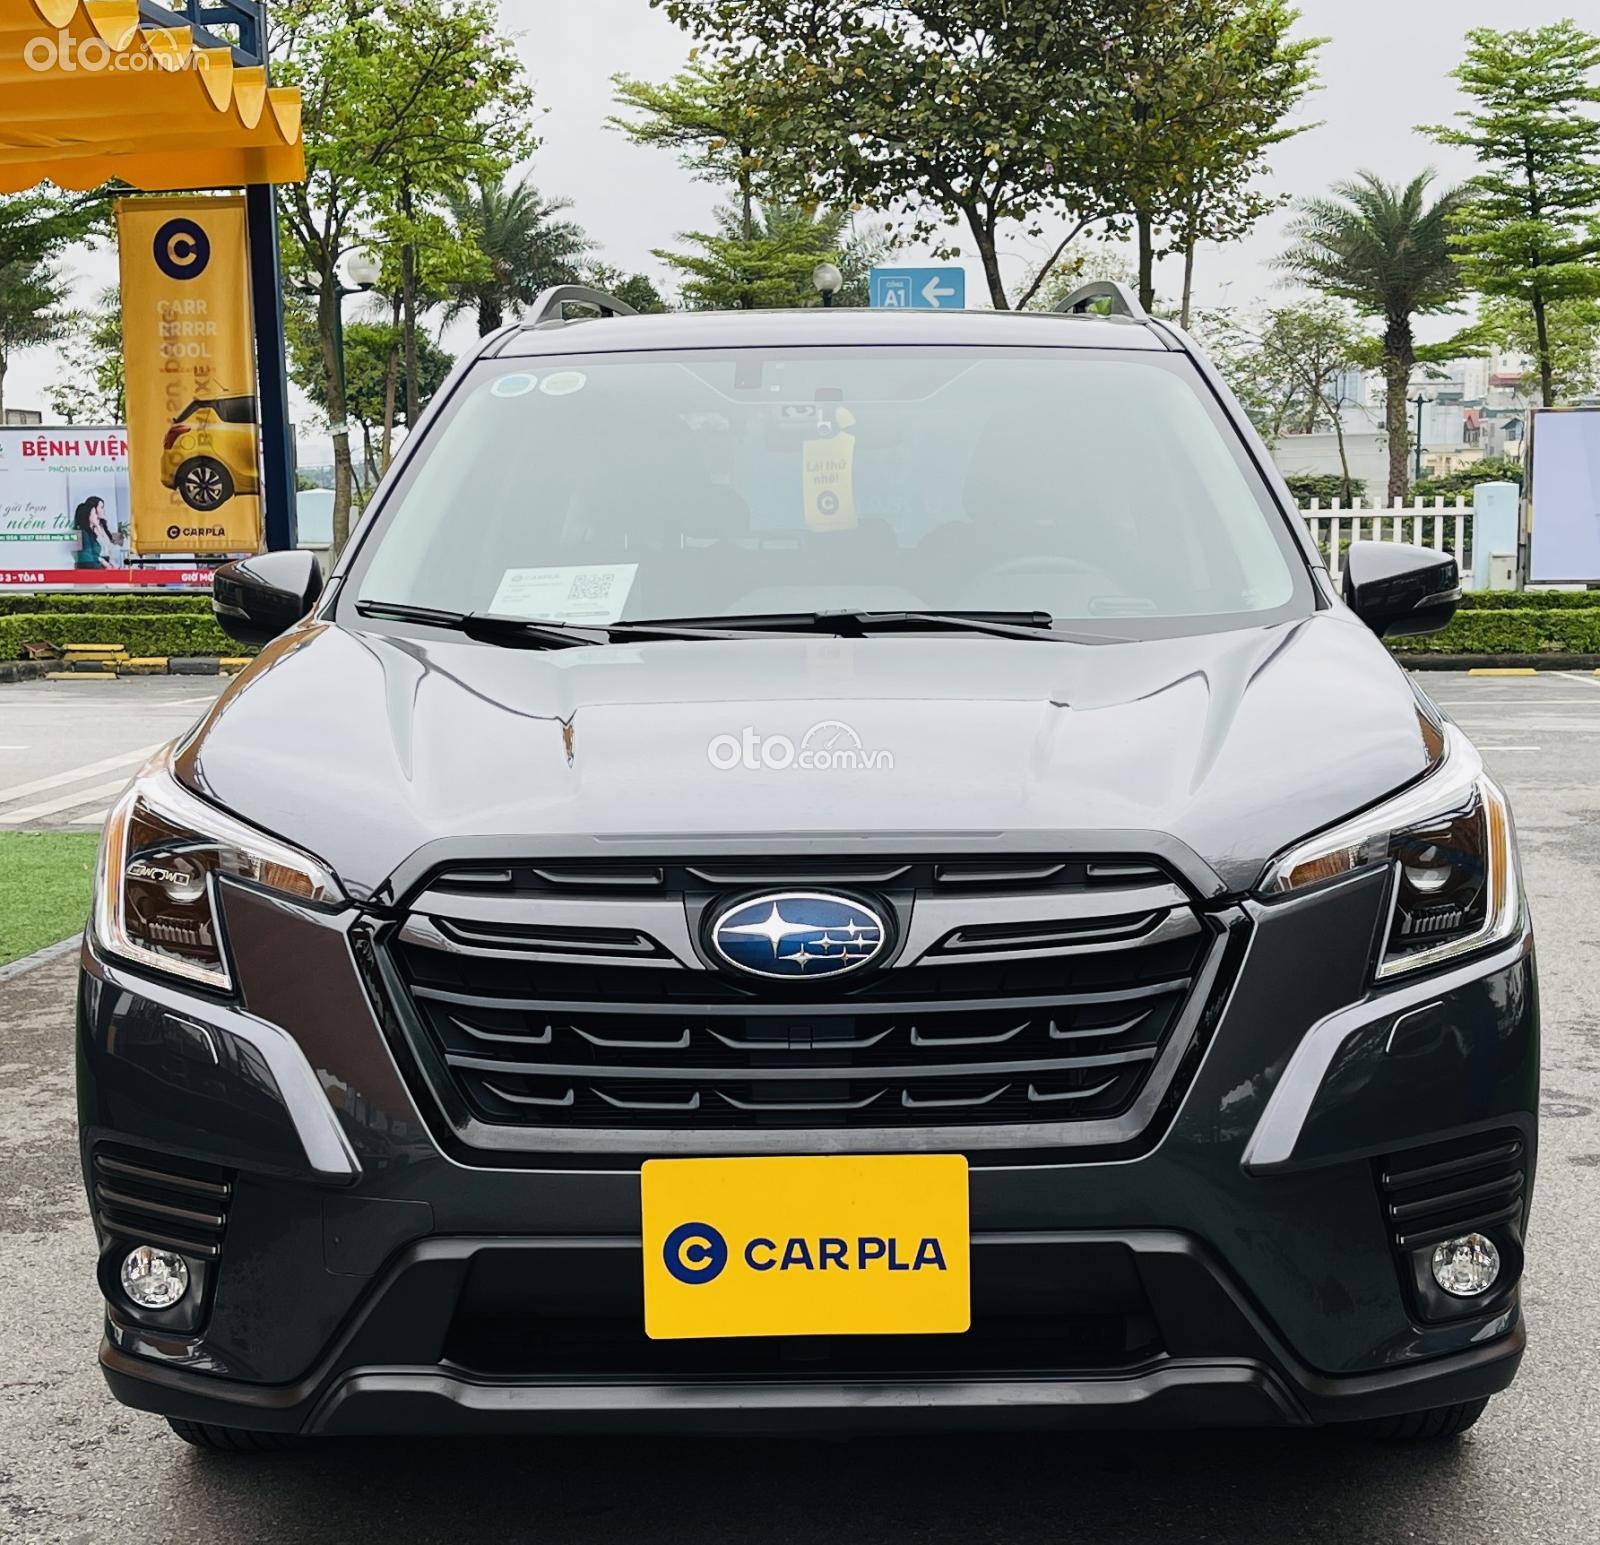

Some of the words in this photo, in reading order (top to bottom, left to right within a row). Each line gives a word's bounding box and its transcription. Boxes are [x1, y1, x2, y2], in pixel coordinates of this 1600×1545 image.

[884, 289, 906, 307] A1
[22, 435, 80, 461] BỆNH
[183, 527, 225, 537] CARPLA
